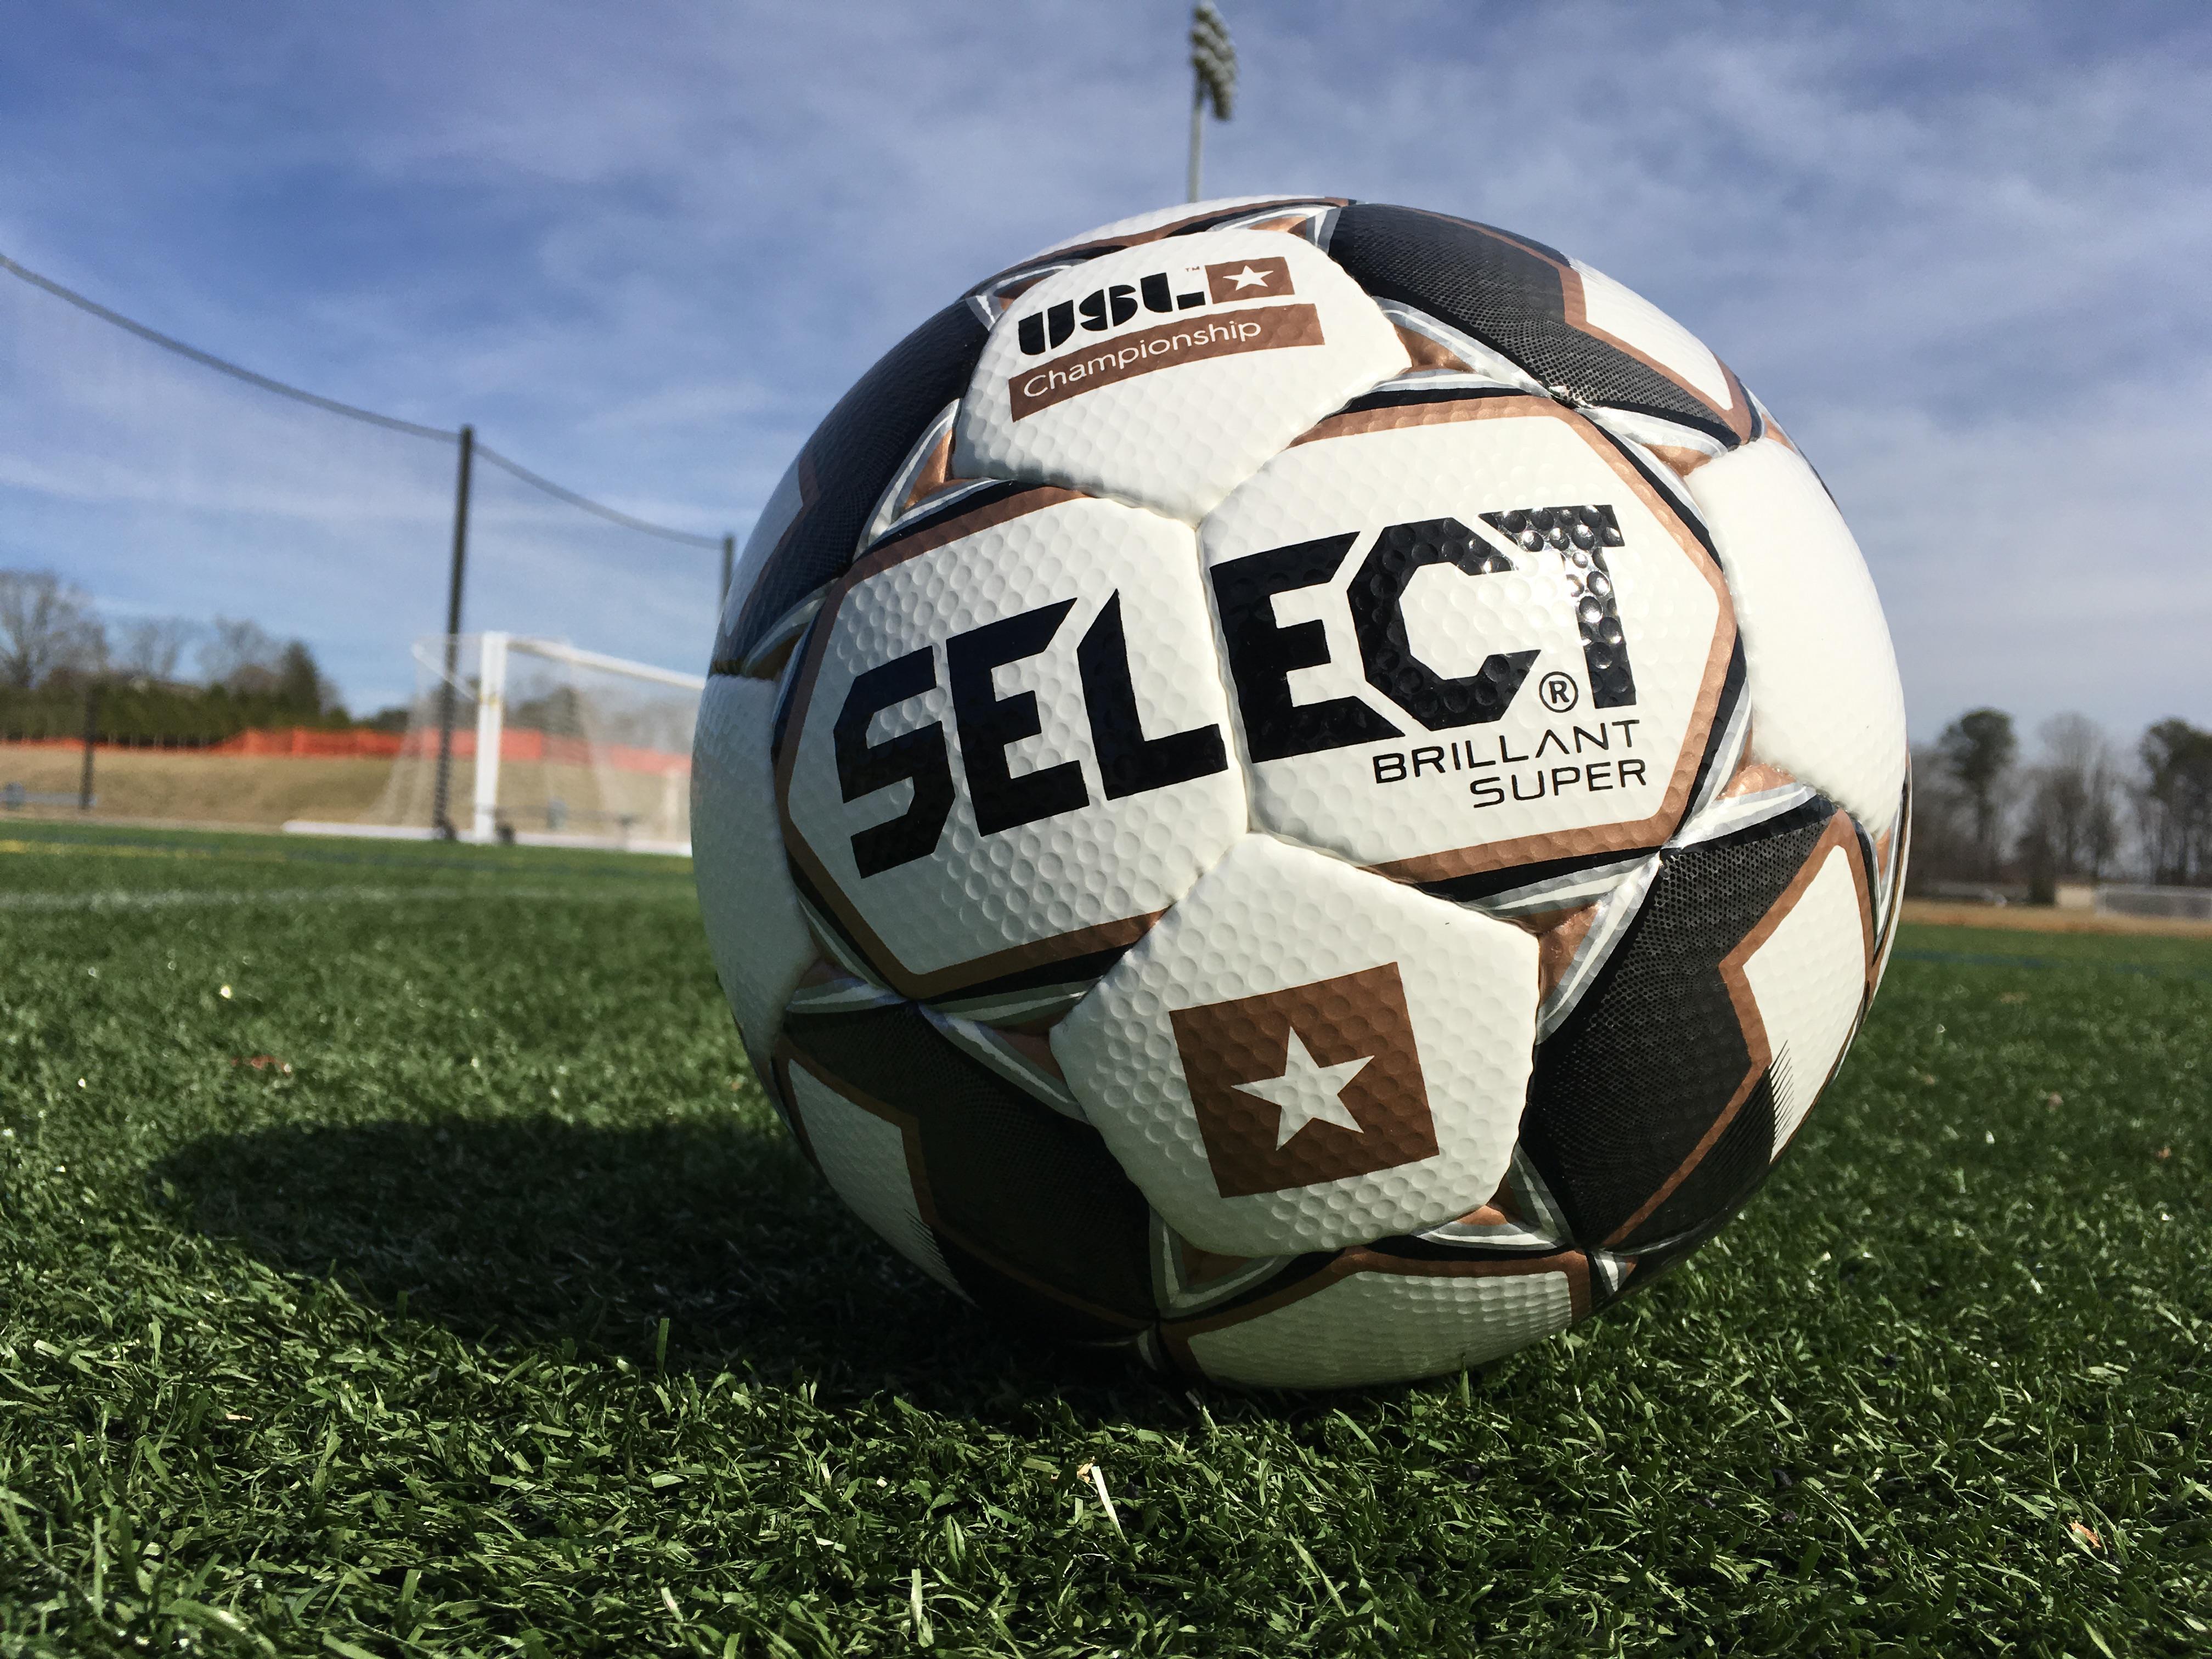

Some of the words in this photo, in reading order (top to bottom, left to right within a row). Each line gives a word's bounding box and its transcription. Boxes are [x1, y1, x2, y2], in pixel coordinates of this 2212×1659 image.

[1018, 272, 1206, 356] USL
[1023, 320, 1262, 398] Championship
[833, 504, 1637, 879] SELECT
[1470, 759, 1646, 808] SUPER
